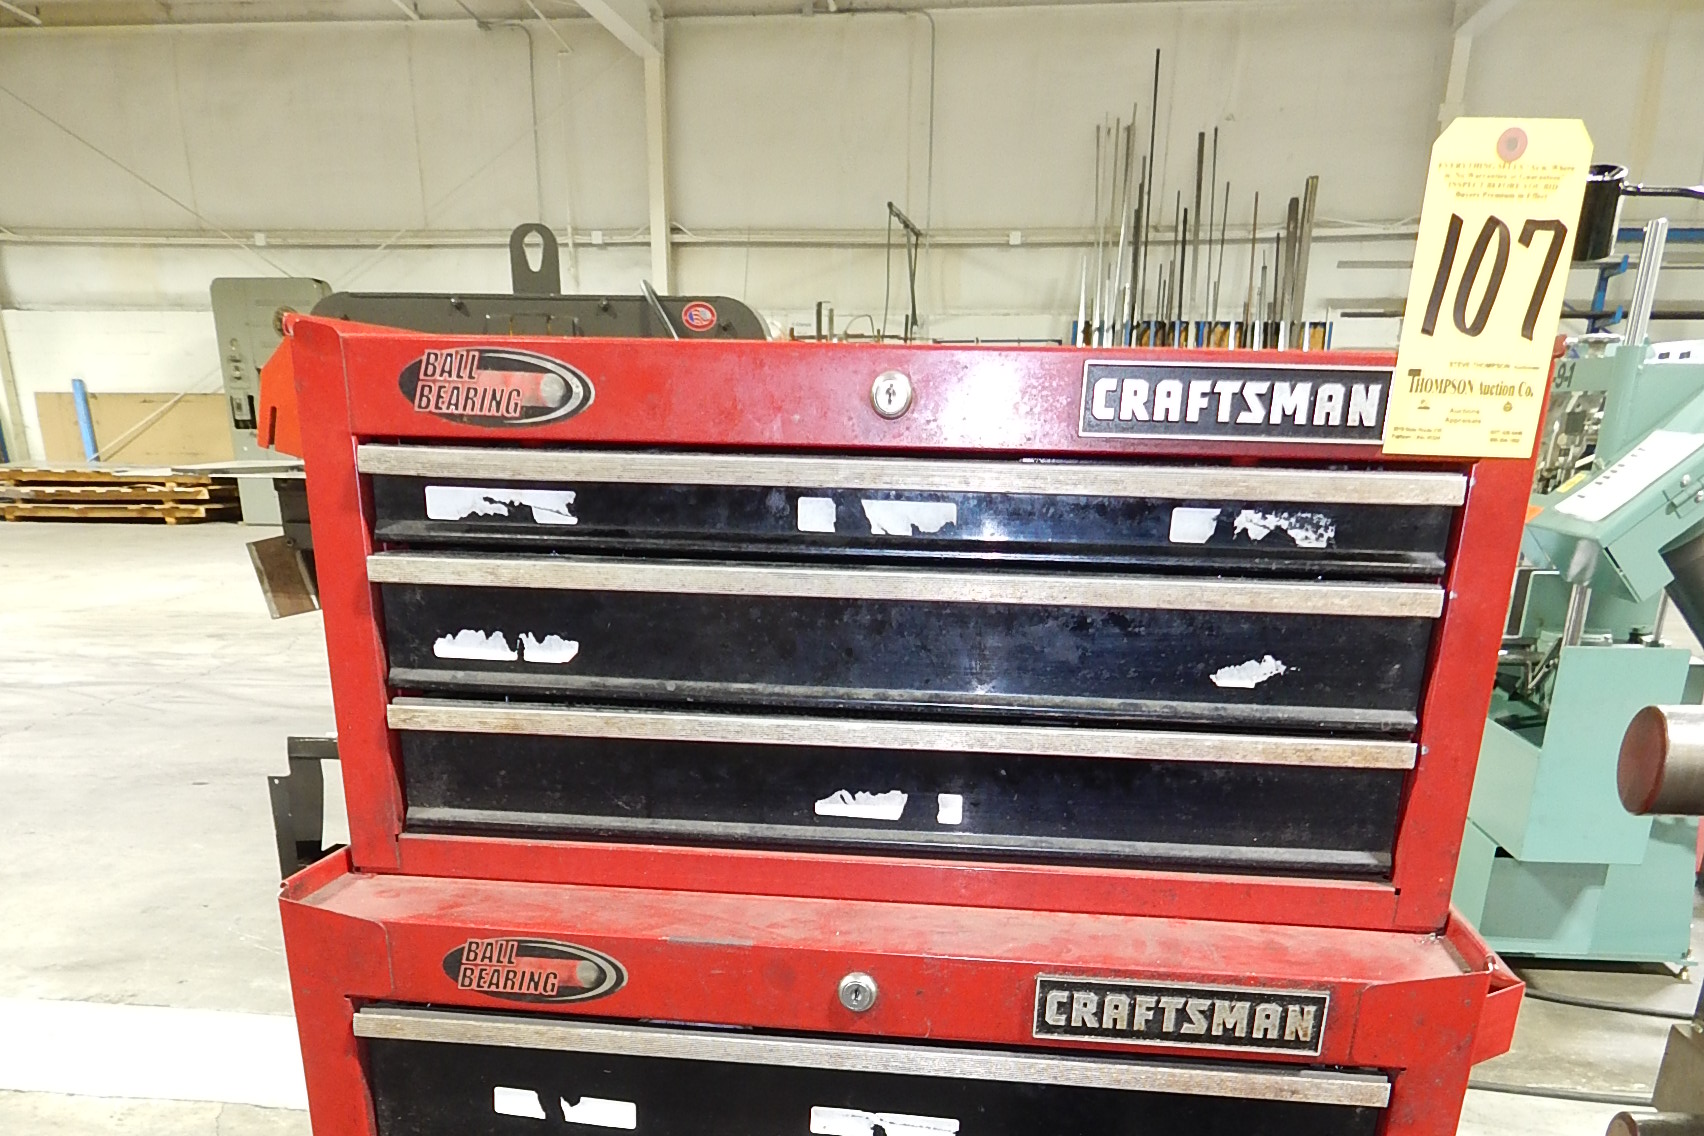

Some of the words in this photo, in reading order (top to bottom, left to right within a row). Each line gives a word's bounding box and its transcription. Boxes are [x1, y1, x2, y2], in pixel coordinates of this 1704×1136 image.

[1421, 213, 1568, 341] 107
[422, 350, 479, 381] BALL
[1407, 369, 1474, 395] THOMPSON
[416, 383, 522, 417] BEARING
[1091, 377, 1382, 428] CRAFTSMAN
[463, 940, 518, 965] BALL
[459, 966, 559, 995] BEARING
[1044, 989, 1318, 1042] CRAFTSMAN
